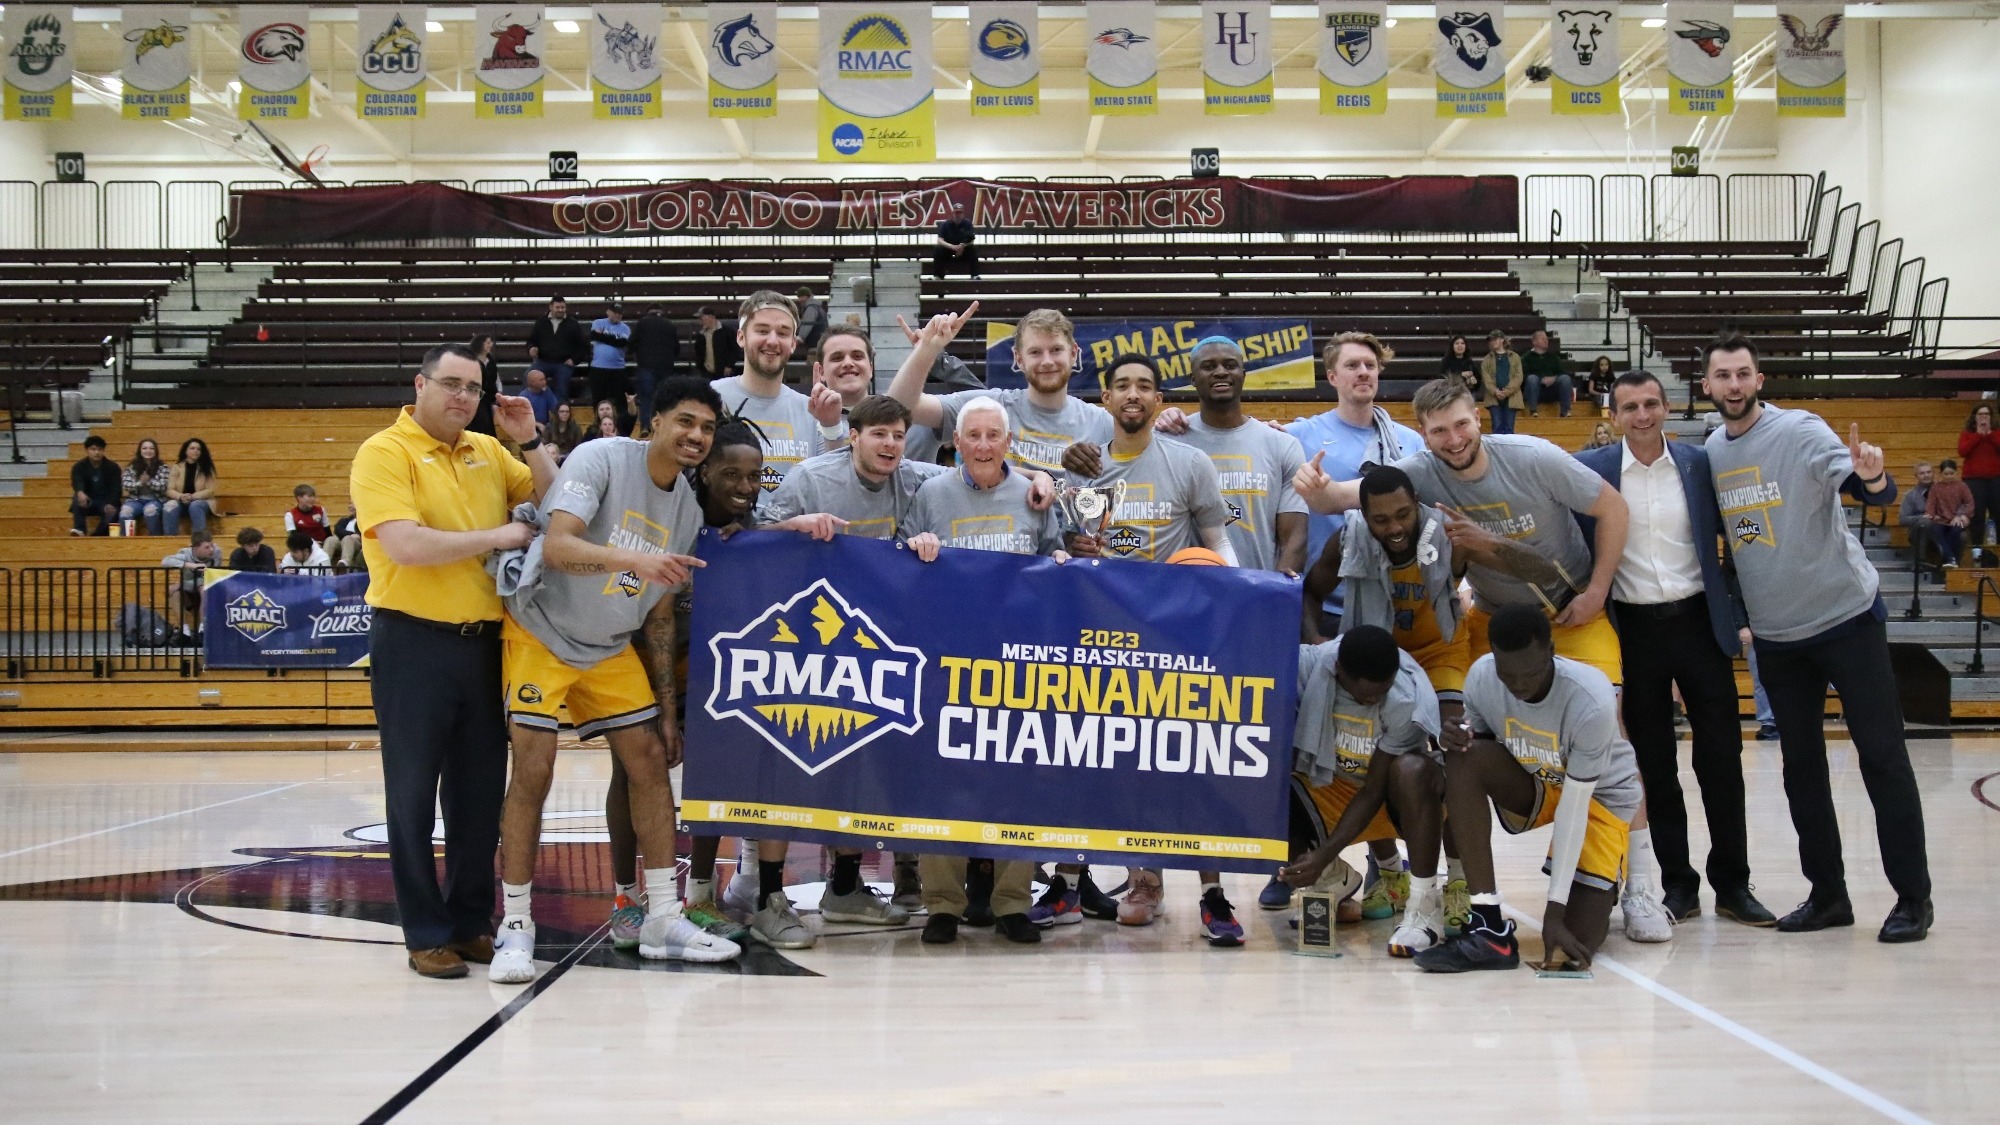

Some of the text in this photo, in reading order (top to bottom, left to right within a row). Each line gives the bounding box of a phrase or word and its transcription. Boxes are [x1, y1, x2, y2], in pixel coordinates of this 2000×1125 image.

[1326, 12, 1380, 27] REGIS
[363, 52, 420, 74] CCU
[838, 50, 912, 69] RMAC
[19, 95, 54, 106] ADAMS
[124, 94, 186, 105] BLACK HILLS
[251, 95, 297, 106] CHADRON
[365, 94, 417, 105] COLORADO
[484, 92, 534, 103] COLORADO
[602, 93, 651, 104] COLORADO
[976, 95, 1034, 106] FORT LEWIS
[1206, 95, 1271, 105] NM HIGHLANDS
[1438, 92, 1504, 102] SOUTH DAKOTA
[1571, 92, 1601, 104] UCCS
[1680, 89, 1725, 100] WESTERN
[713, 97, 772, 108] CSU-PUEBLO
[1094, 95, 1153, 107] METRO STATE
[1336, 95, 1371, 107] REGIS
[1689, 101, 1717, 112] STATE
[1778, 97, 1844, 107] WESTMINSTER
[22, 107, 52, 118] STATE
[140, 106, 170, 118] STATE
[260, 106, 288, 118] STATE
[364, 105, 417, 117] CHRISTIAN
[494, 104, 523, 115] MESA
[610, 105, 643, 116] MINES
[1456, 104, 1486, 113] MINES
[835, 138, 864, 147] NCAA
[878, 139, 914, 149] Division
[56, 158, 83, 175] 101
[549, 157, 578, 174] 102
[1192, 154, 1219, 170] 103
[1672, 153, 1699, 169] 104
[552, 187, 1225, 235] COLORADO MESA MAVERICKS
[1090, 320, 1199, 368] RMAC
[761, 475, 784, 483] MAC
[1736, 525, 1760, 539] RMAC
[1111, 538, 1140, 548] RMAC
[561, 560, 608, 573] VICTOR
[620, 574, 640, 588] RMA
[230, 607, 282, 624] RMAC
[333, 605, 361, 614] MAKE
[308, 609, 372, 640] YOURS
[1080, 629, 1140, 649] 2023
[1002, 643, 1216, 673] MEN'S BASKETBALL
[726, 648, 909, 716] RMAC
[940, 656, 1275, 724] TOURNAMENT
[938, 705, 1271, 778] CHAMPIONS
[728, 808, 814, 824] /RMACSPORTS
[852, 819, 950, 836] @RMAC_SPORTS
[1001, 830, 1089, 845] RMAC_SPORTS
[1117, 836, 1262, 854] #EVERYTHINGELEVATED
